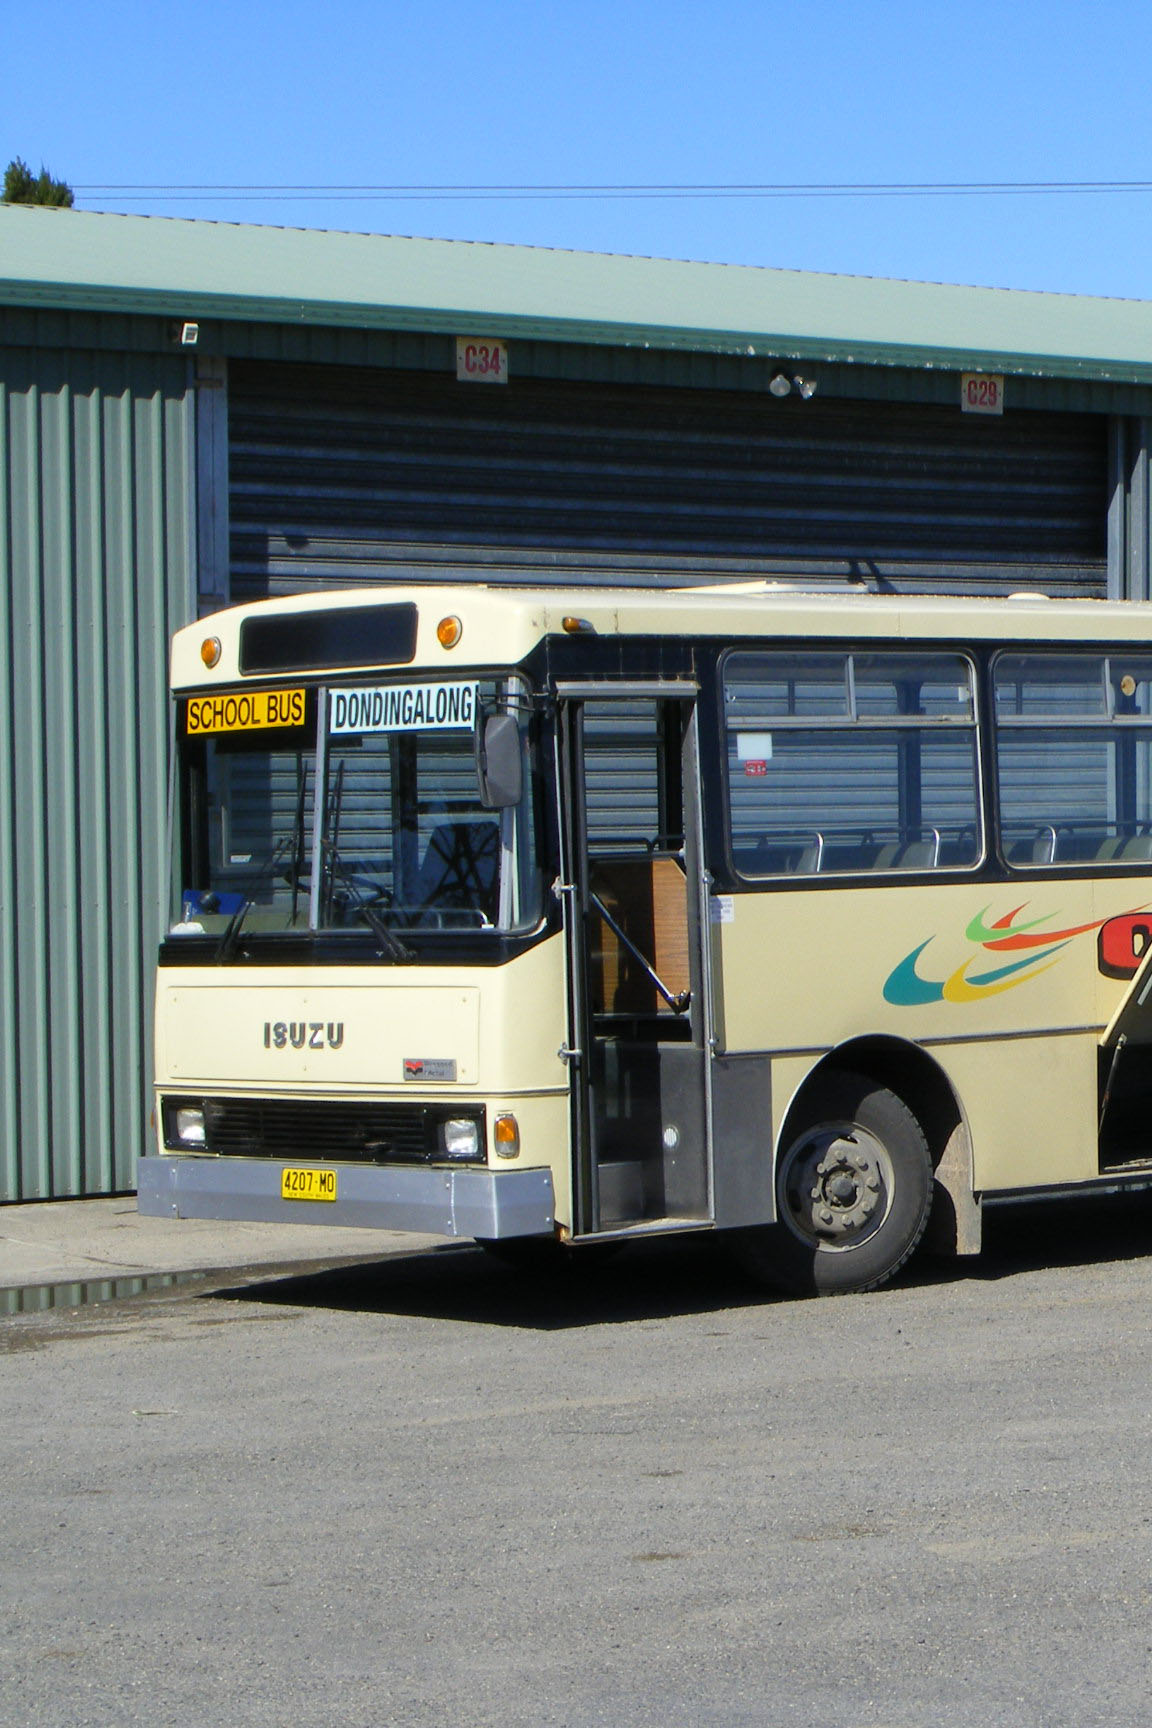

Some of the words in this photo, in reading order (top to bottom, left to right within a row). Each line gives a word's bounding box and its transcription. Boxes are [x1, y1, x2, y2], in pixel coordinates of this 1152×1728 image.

[465, 345, 501, 374] C34
[189, 694, 260, 730] SCHOOL
[267, 692, 302, 722] BUS
[335, 687, 472, 728] DONDINGALONG
[264, 1022, 344, 1049] ISUZU
